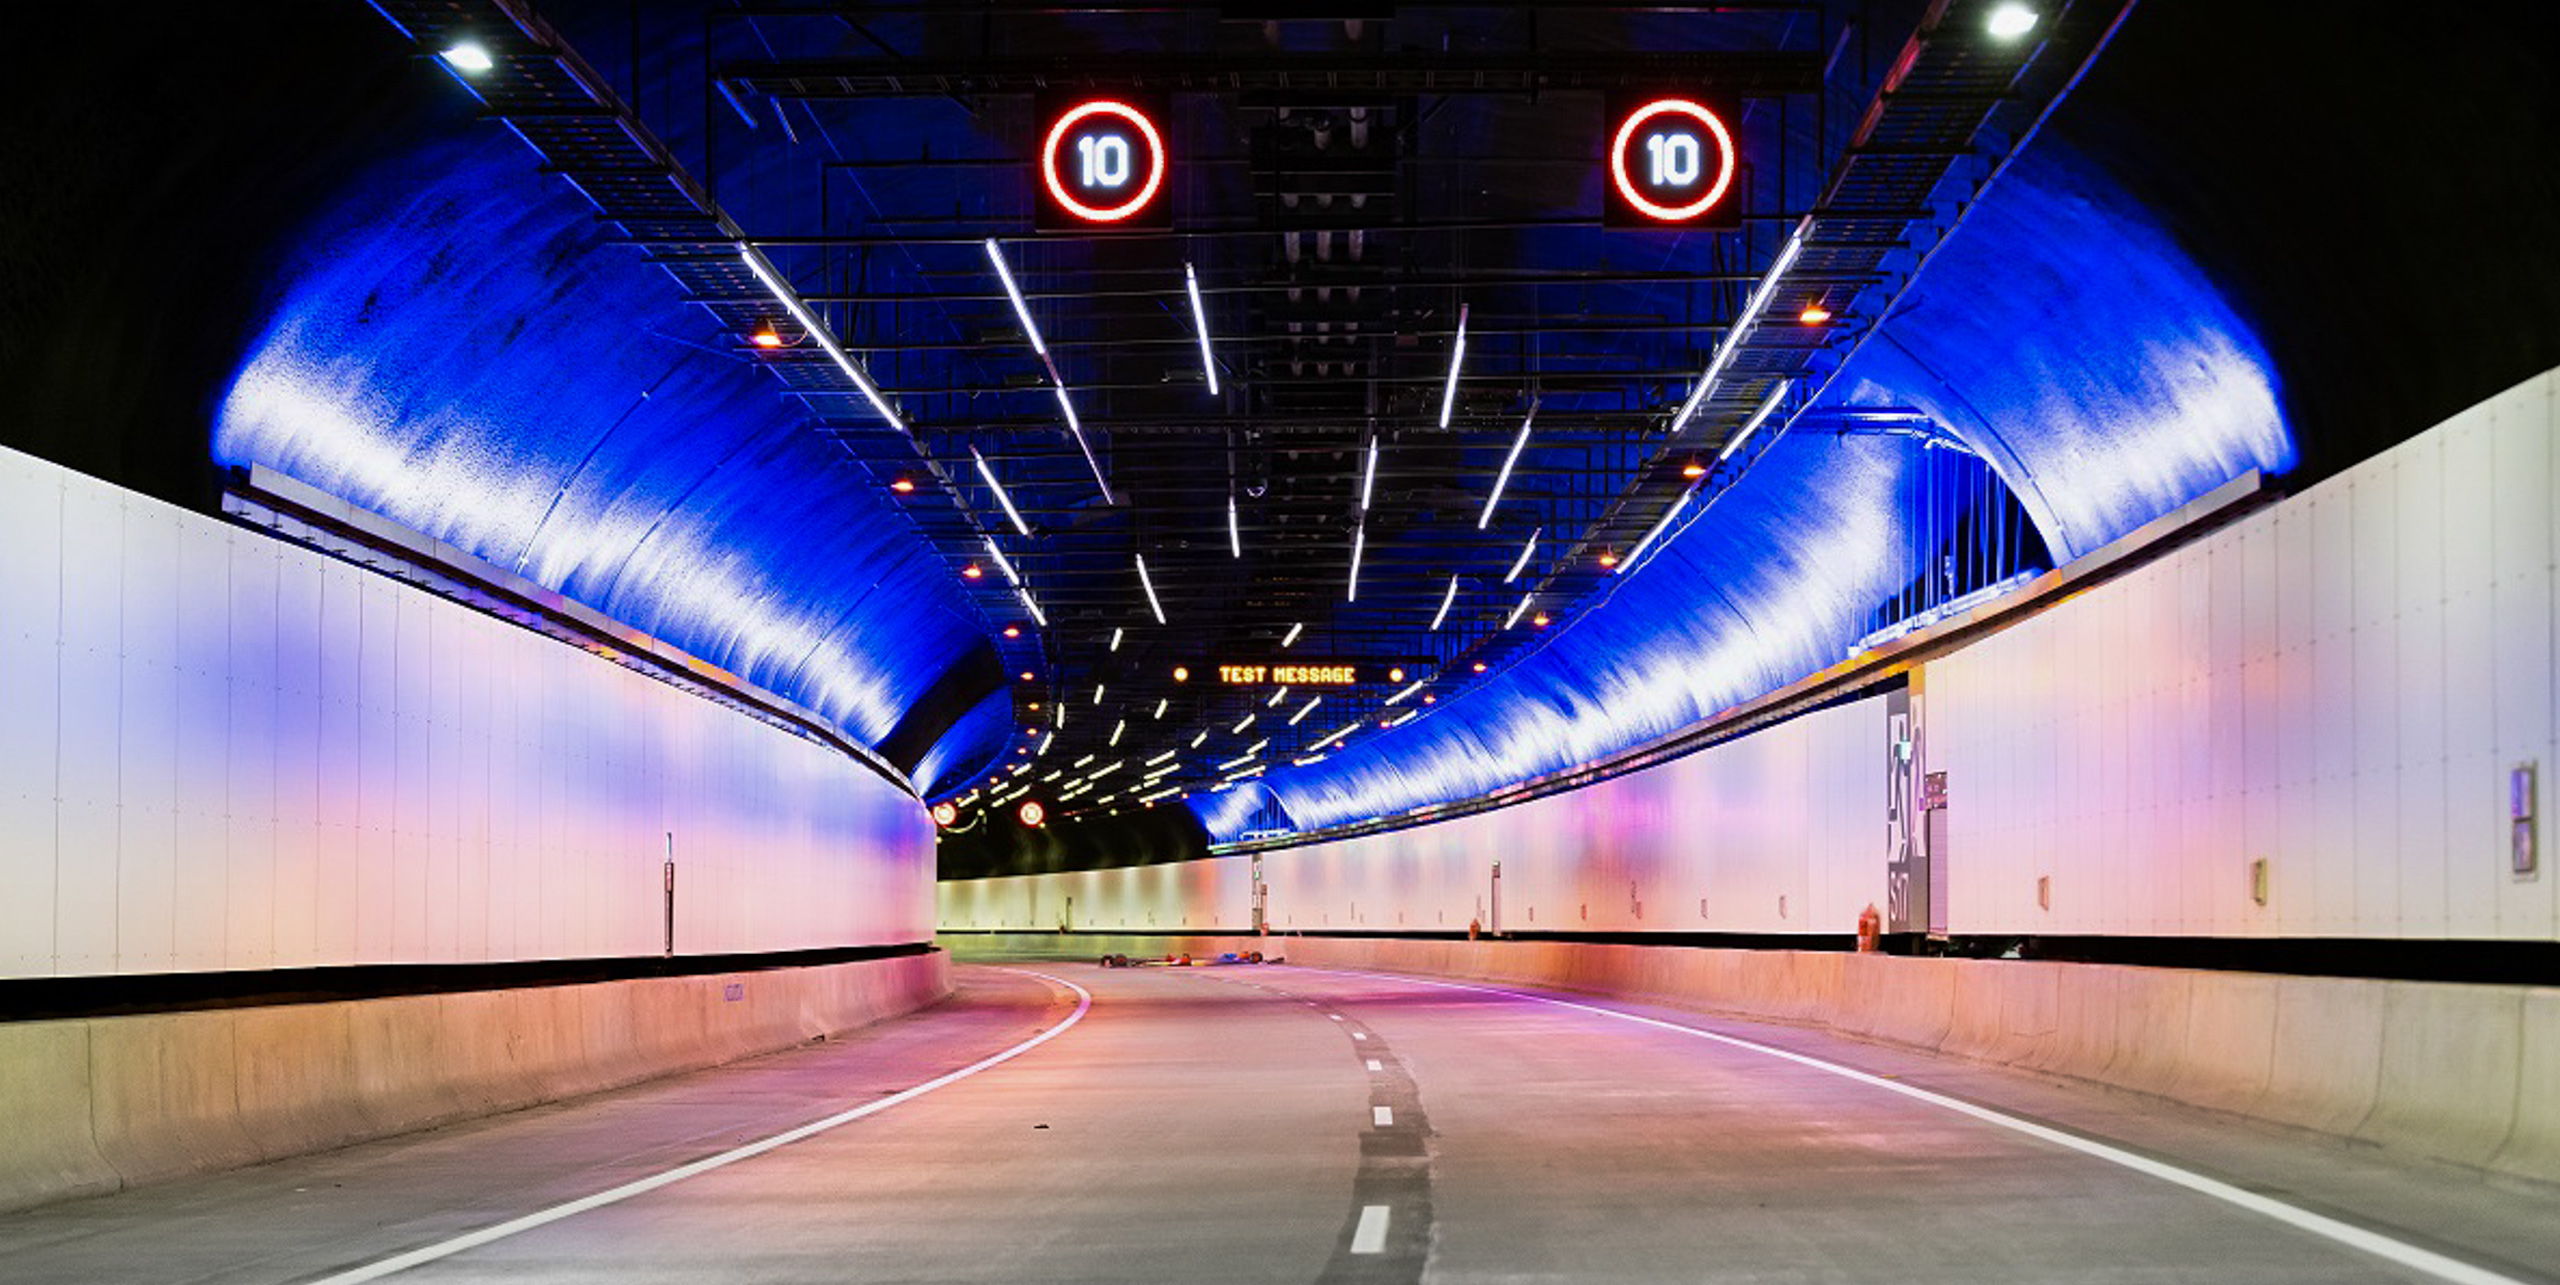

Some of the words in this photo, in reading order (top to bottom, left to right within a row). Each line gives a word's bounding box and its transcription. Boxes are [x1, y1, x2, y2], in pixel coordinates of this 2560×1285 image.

[1078, 135, 1129, 187] 10
[1647, 134, 1699, 186] 10
[1219, 666, 1266, 682] TEST
[1273, 666, 1355, 682] MESSAGE
